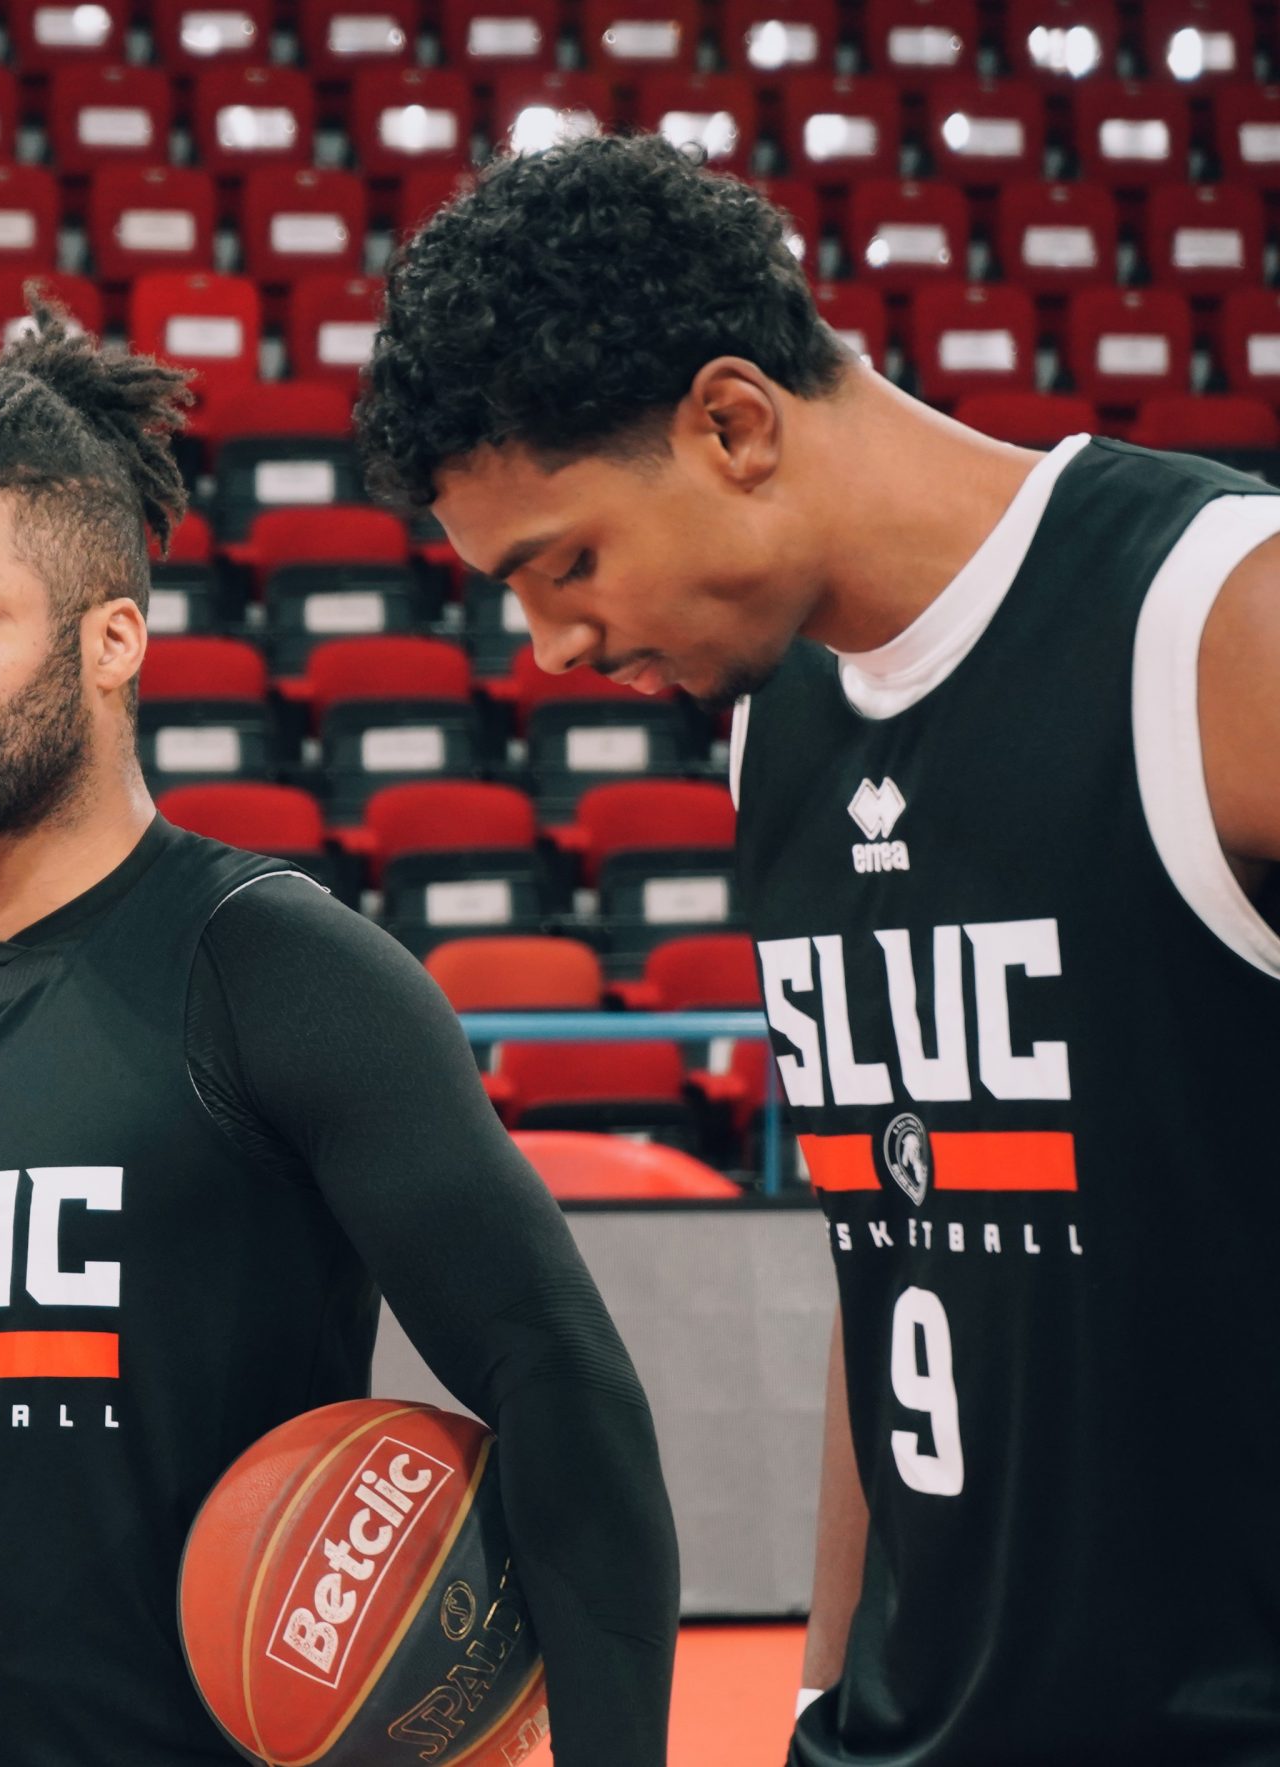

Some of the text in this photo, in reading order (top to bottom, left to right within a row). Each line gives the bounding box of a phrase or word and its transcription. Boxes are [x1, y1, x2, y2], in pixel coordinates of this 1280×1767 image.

[757, 918, 1072, 1108] SLUC
[892, 1287, 964, 1497] 9
[282, 1453, 433, 1674] Betclic
